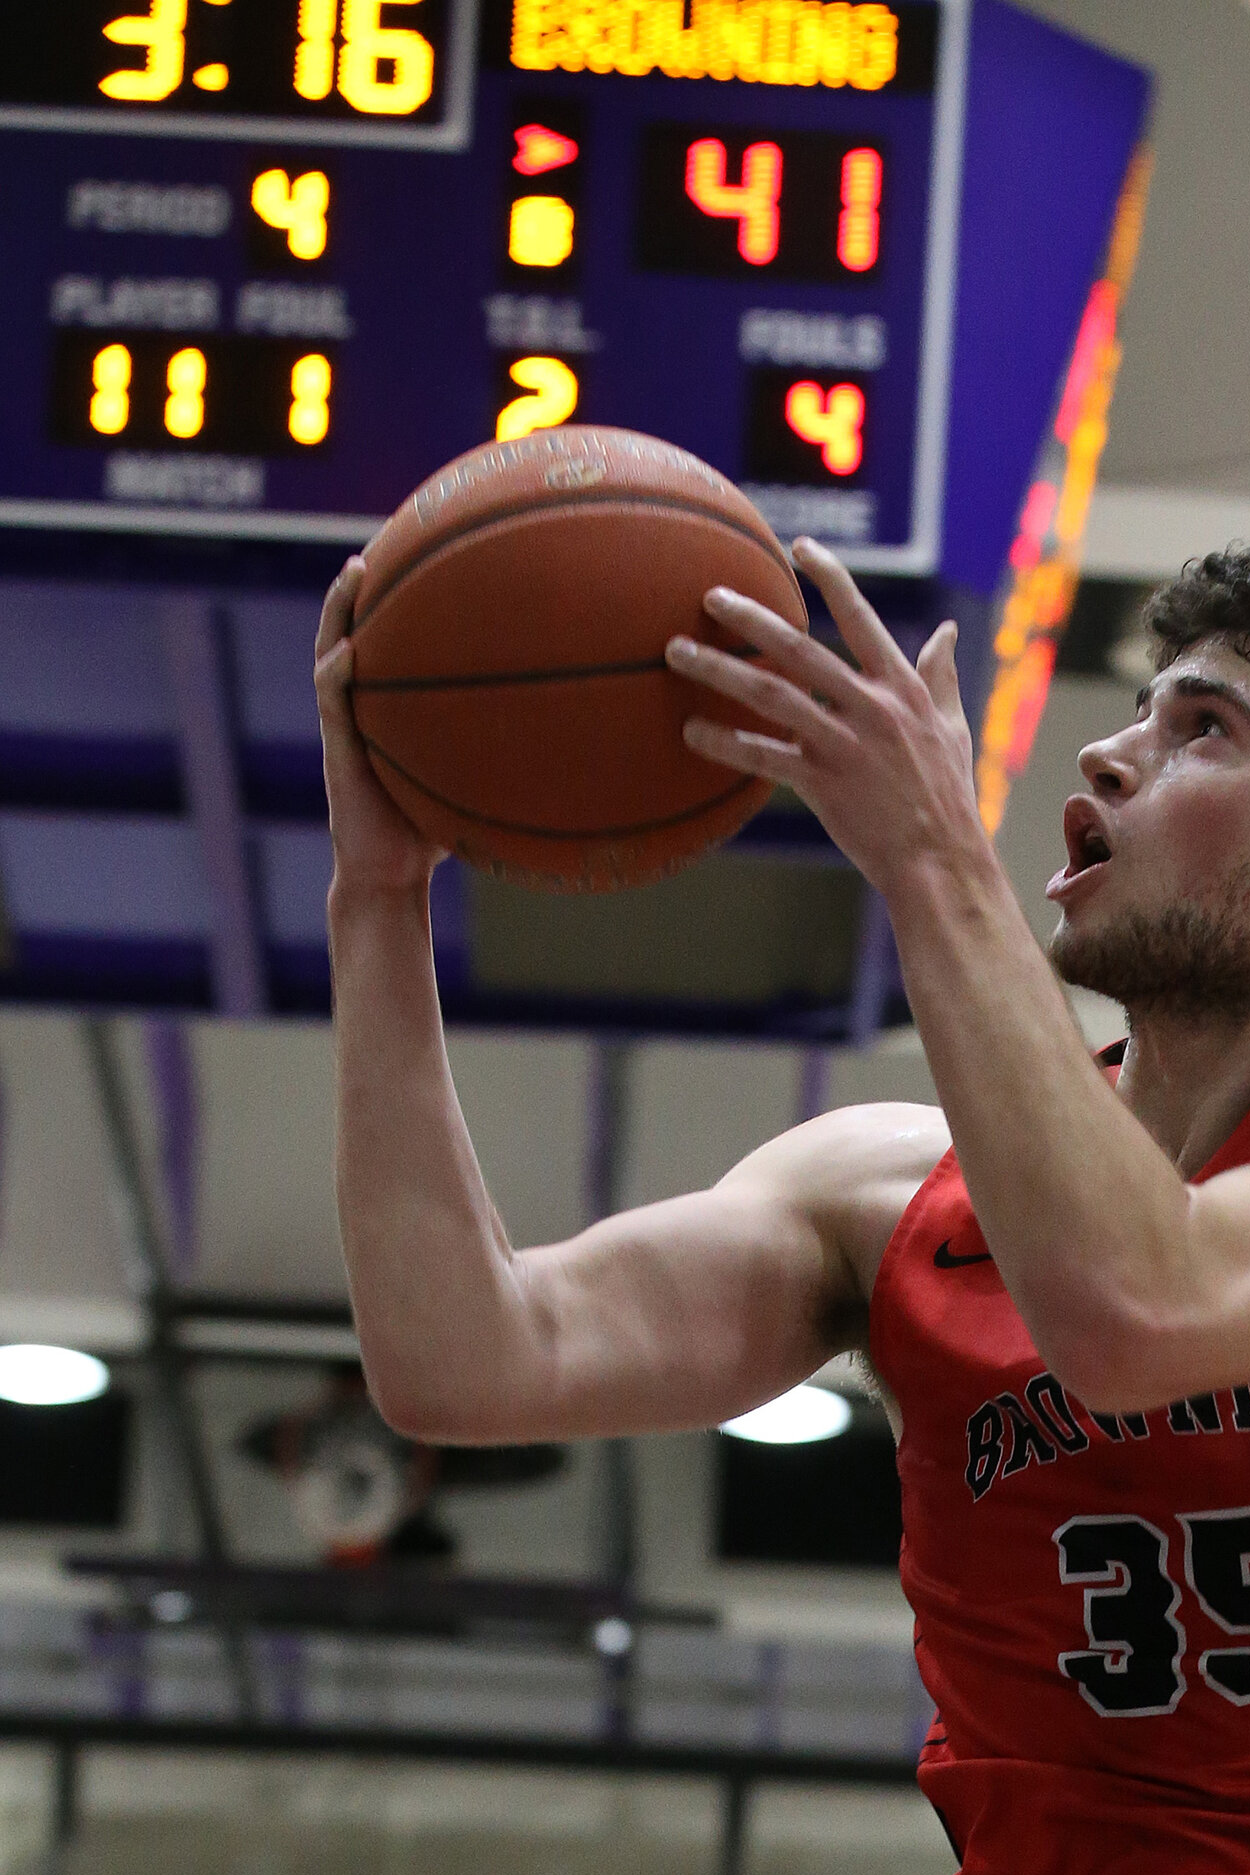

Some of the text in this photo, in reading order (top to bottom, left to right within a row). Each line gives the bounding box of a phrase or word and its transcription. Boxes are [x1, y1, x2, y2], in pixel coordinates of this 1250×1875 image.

[98, 0, 434, 115] 3:16
[510, 0, 899, 90] BROWNING
[251, 169, 330, 260] 4
[685, 138, 883, 272] 41
[288, 353, 331, 446] 1
[496, 357, 578, 443] 2
[785, 380, 865, 476] 4
